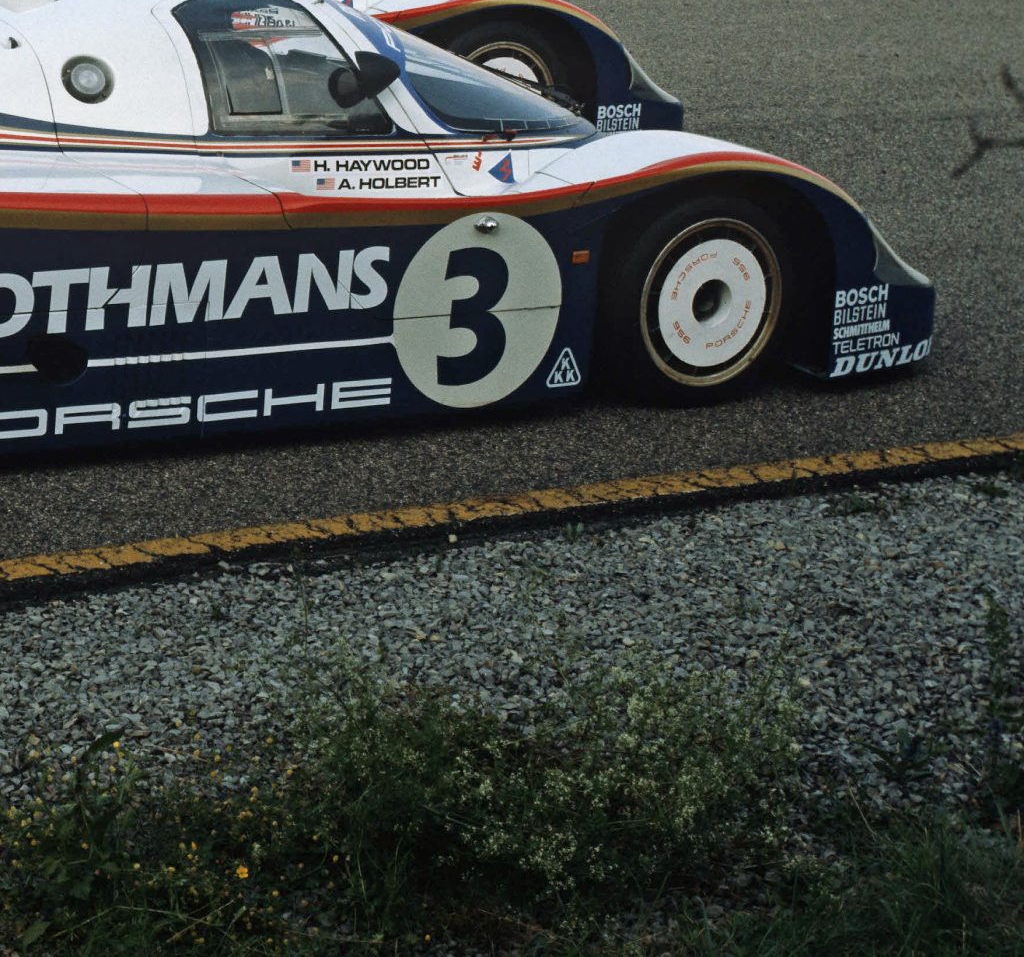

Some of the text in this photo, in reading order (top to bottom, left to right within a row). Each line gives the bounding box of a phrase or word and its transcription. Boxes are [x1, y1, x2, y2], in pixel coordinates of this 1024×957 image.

[597, 103, 642, 119] BOSCH
[596, 117, 640, 132] BILSTEIN
[314, 160, 330, 172] H.
[336, 158, 430, 172] HAYWOOD
[337, 176, 441, 190] A. HOLBERT
[671, 251, 718, 301] PORSCHE
[732, 257, 751, 281] 956
[835, 283, 889, 308] BOSCH
[436, 246, 509, 387] 3
[705, 300, 752, 349] PORSCHE
[833, 302, 887, 326] BILSTEIN
[672, 321, 692, 345] 956
[832, 332, 900, 355] TELETRON
